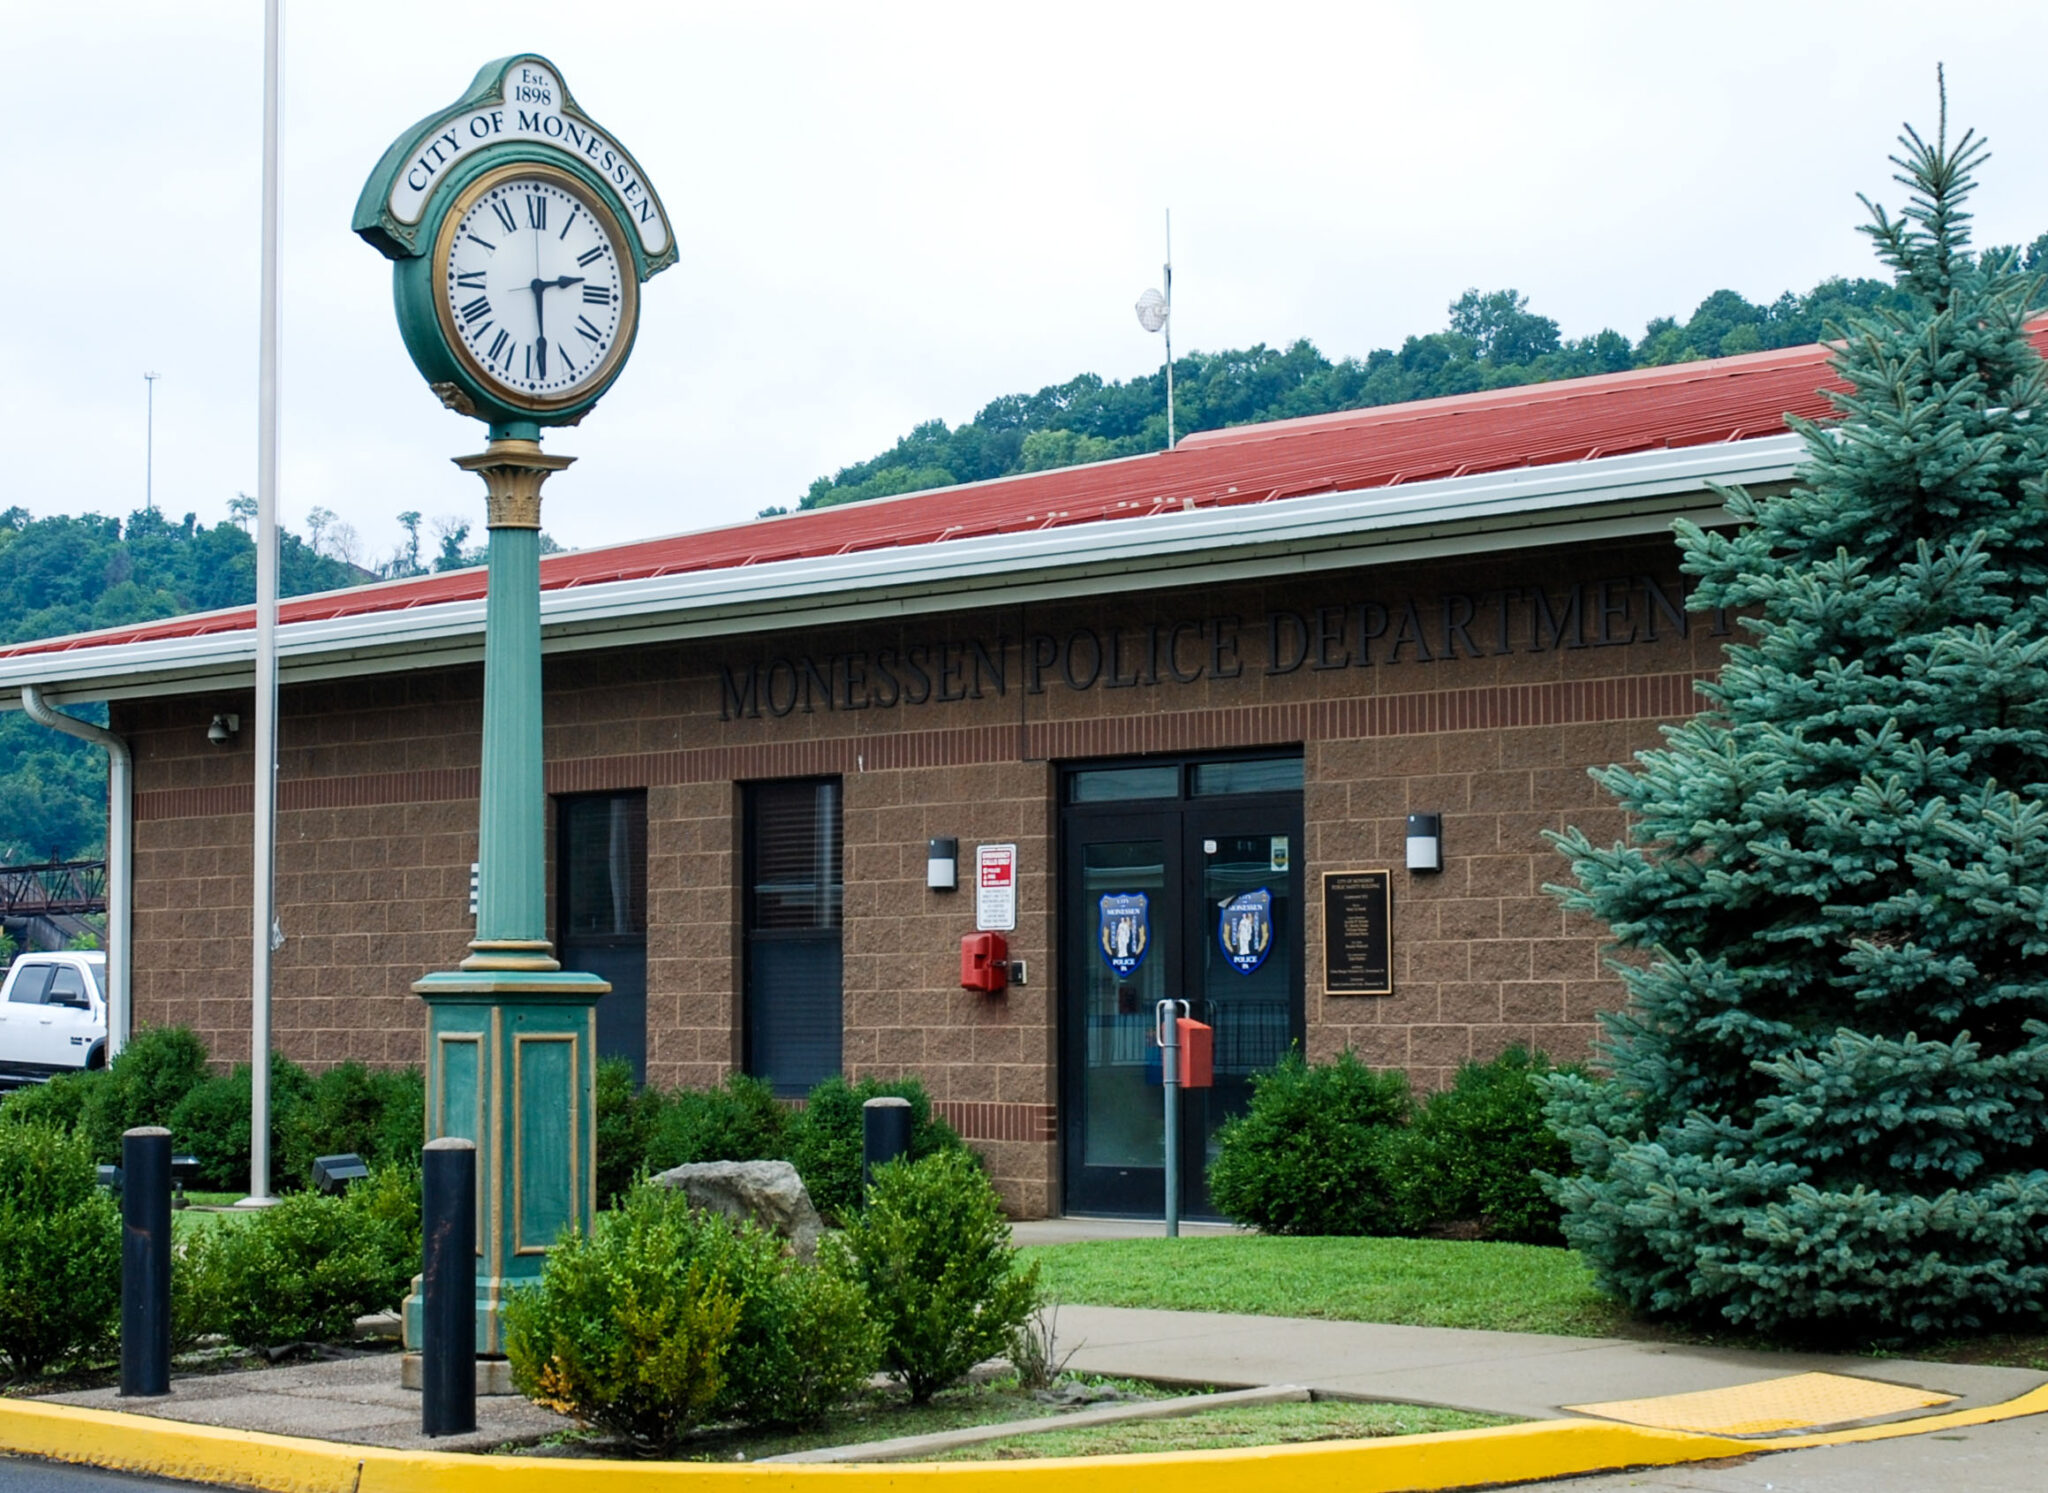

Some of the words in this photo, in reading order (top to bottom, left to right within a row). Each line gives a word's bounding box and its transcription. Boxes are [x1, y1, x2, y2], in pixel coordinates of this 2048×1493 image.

[515, 86, 551, 105] 1898
[522, 69, 548, 86] Est.
[408, 128, 461, 192] CITY
[469, 111, 503, 138] OF
[517, 110, 655, 224] MONESSEN
[491, 198, 517, 237] XI
[525, 194, 546, 231] XII
[560, 211, 576, 240] I
[577, 246, 604, 268] II
[457, 266, 486, 291] IX
[582, 284, 610, 305] III
[460, 295, 496, 341] VIII
[574, 314, 602, 353] IV
[488, 328, 516, 373] VII
[718, 635, 1006, 721] MONESSEN
[1026, 613, 1244, 695] POLICE
